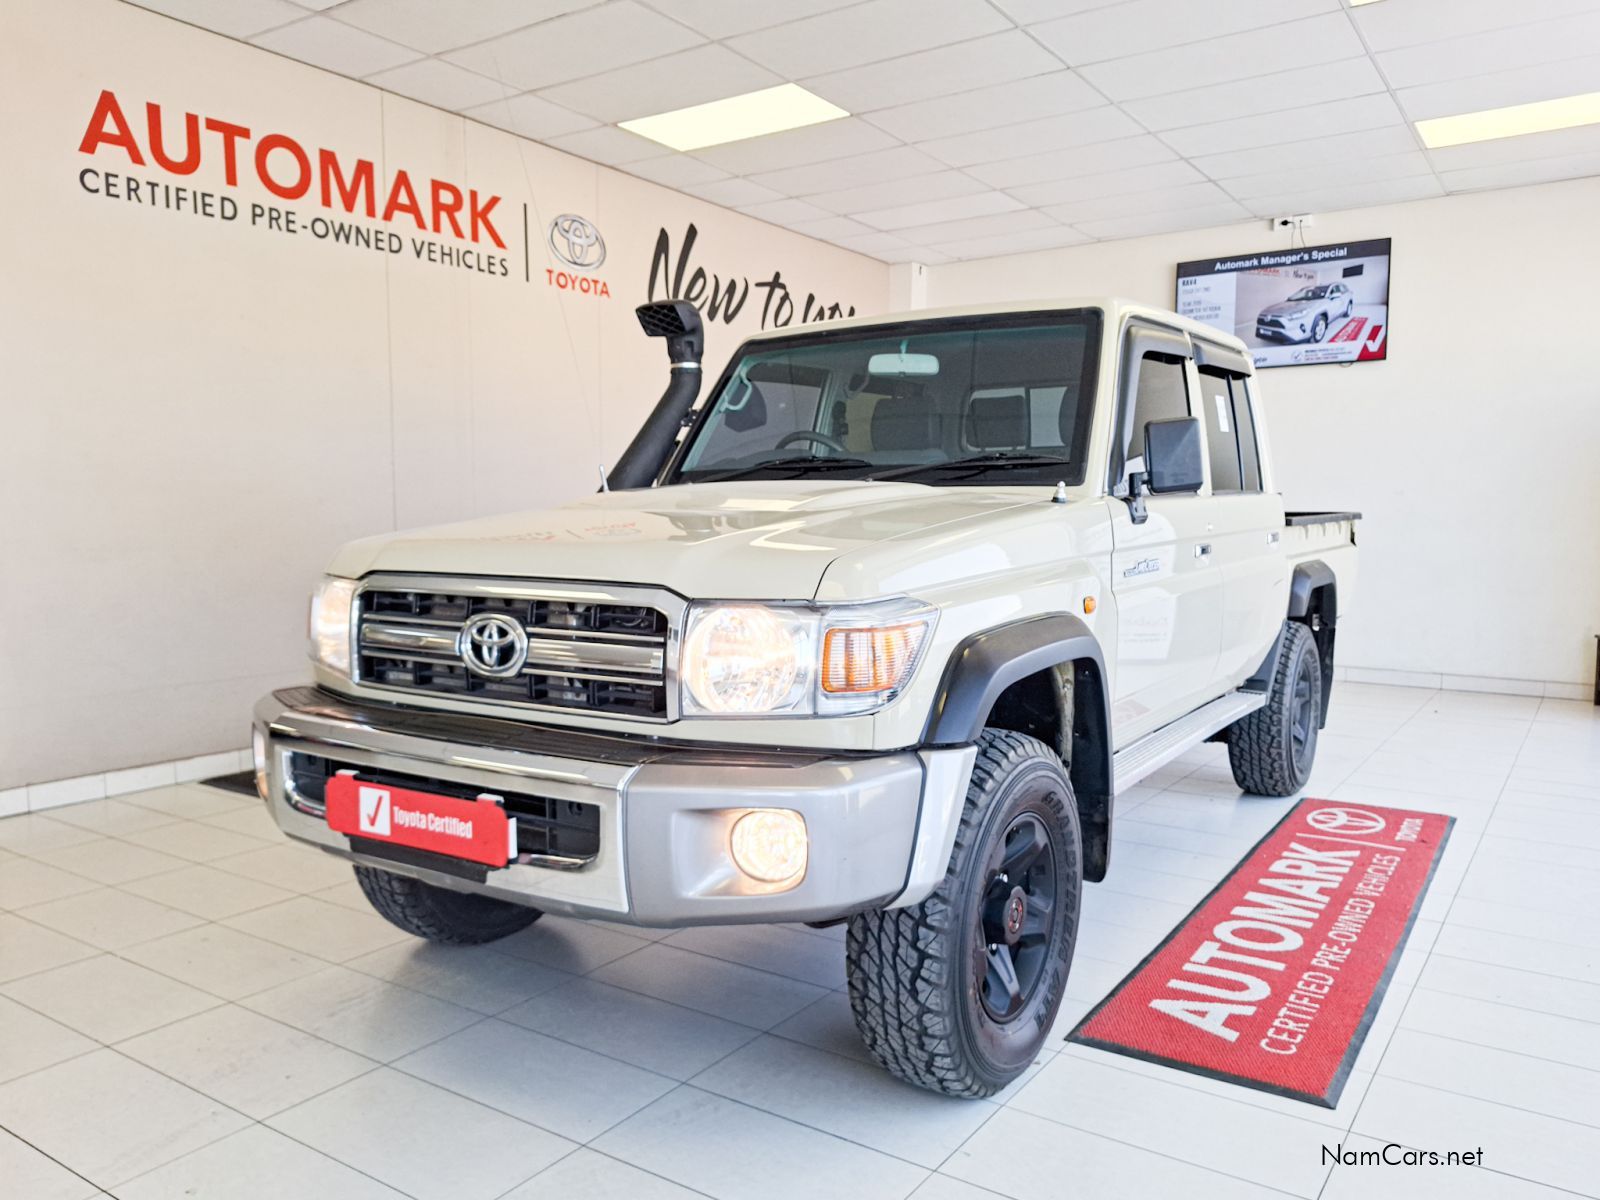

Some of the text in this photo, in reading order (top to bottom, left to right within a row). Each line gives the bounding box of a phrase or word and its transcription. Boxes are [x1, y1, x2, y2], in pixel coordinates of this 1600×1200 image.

[78, 89, 507, 250] AUTOMARK
[79, 168, 509, 277] CERTIFIED PRE-OWNED VEHICLES
[546, 269, 611, 298] TOYOTA
[648, 222, 794, 330] New to
[1214, 247, 1348, 271] Automark Manager's Special
[393, 806, 473, 839] Toyota Certified
[1148, 842, 1360, 1043] AUTOMARK
[1260, 854, 1400, 1056] CERTIFIED PRE-OWNED VEHICLES
